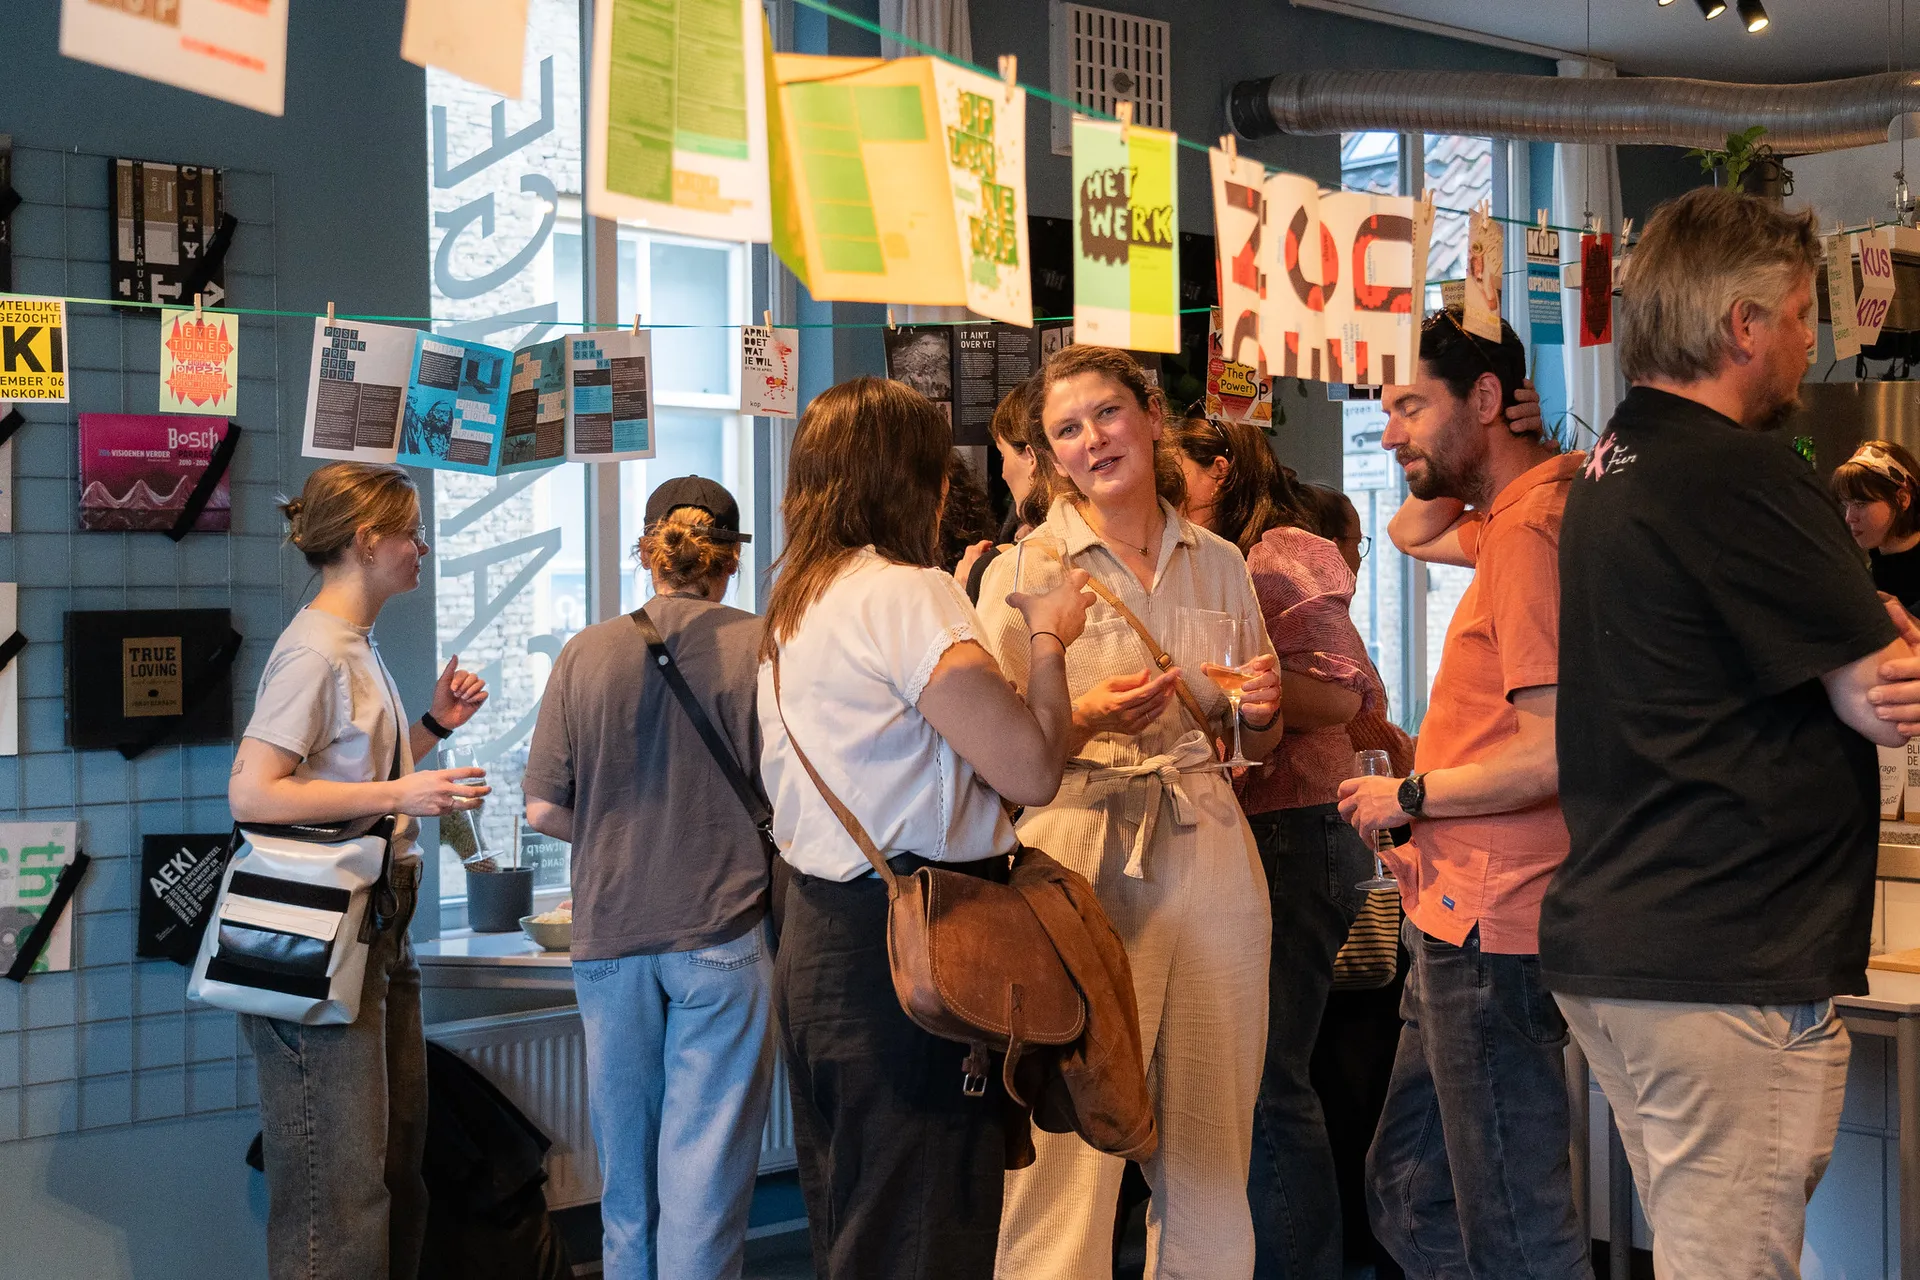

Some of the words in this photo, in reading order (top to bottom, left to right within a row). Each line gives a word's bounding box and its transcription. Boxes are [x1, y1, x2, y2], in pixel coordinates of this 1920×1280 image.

[1086, 167, 1138, 200] HET
[1088, 205, 1173, 243] WERK
[1527, 229, 1559, 256] KOP
[185, 328, 215, 339] EYE
[325, 328, 357, 339] POST
[744, 328, 770, 338] APRIL
[960, 331, 968, 339] IT
[970, 331, 989, 339] AIN'T
[174, 340, 226, 352] TUNES
[333, 340, 365, 350] PUNK
[575, 340, 595, 349] PRO
[744, 338, 767, 347] DOET
[960, 341, 981, 349] OVER
[982, 340, 996, 349] YET
[2, 326, 64, 373] KI
[323, 349, 347, 359] PRO
[574, 350, 602, 359] GRAM
[744, 347, 763, 356] WAT
[322, 358, 354, 369] GRES
[744, 357, 753, 365] IE
[756, 358, 772, 367] WIL
[321, 369, 353, 380] SION
[1227, 368, 1244, 380] The
[1221, 380, 1253, 393] Power!
[1, 389, 65, 398] NGKOP.NL
[129, 647, 176, 662] TRUE
[131, 663, 177, 677] LOVING
[1907, 756, 1918, 766] DE
[150, 847, 198, 898] AEKI
[187, 865, 212, 890] ONTWERP
[197, 883, 215, 901] KUNST
[169, 889, 189, 909] DESIGN
[185, 905, 198, 918] AND
